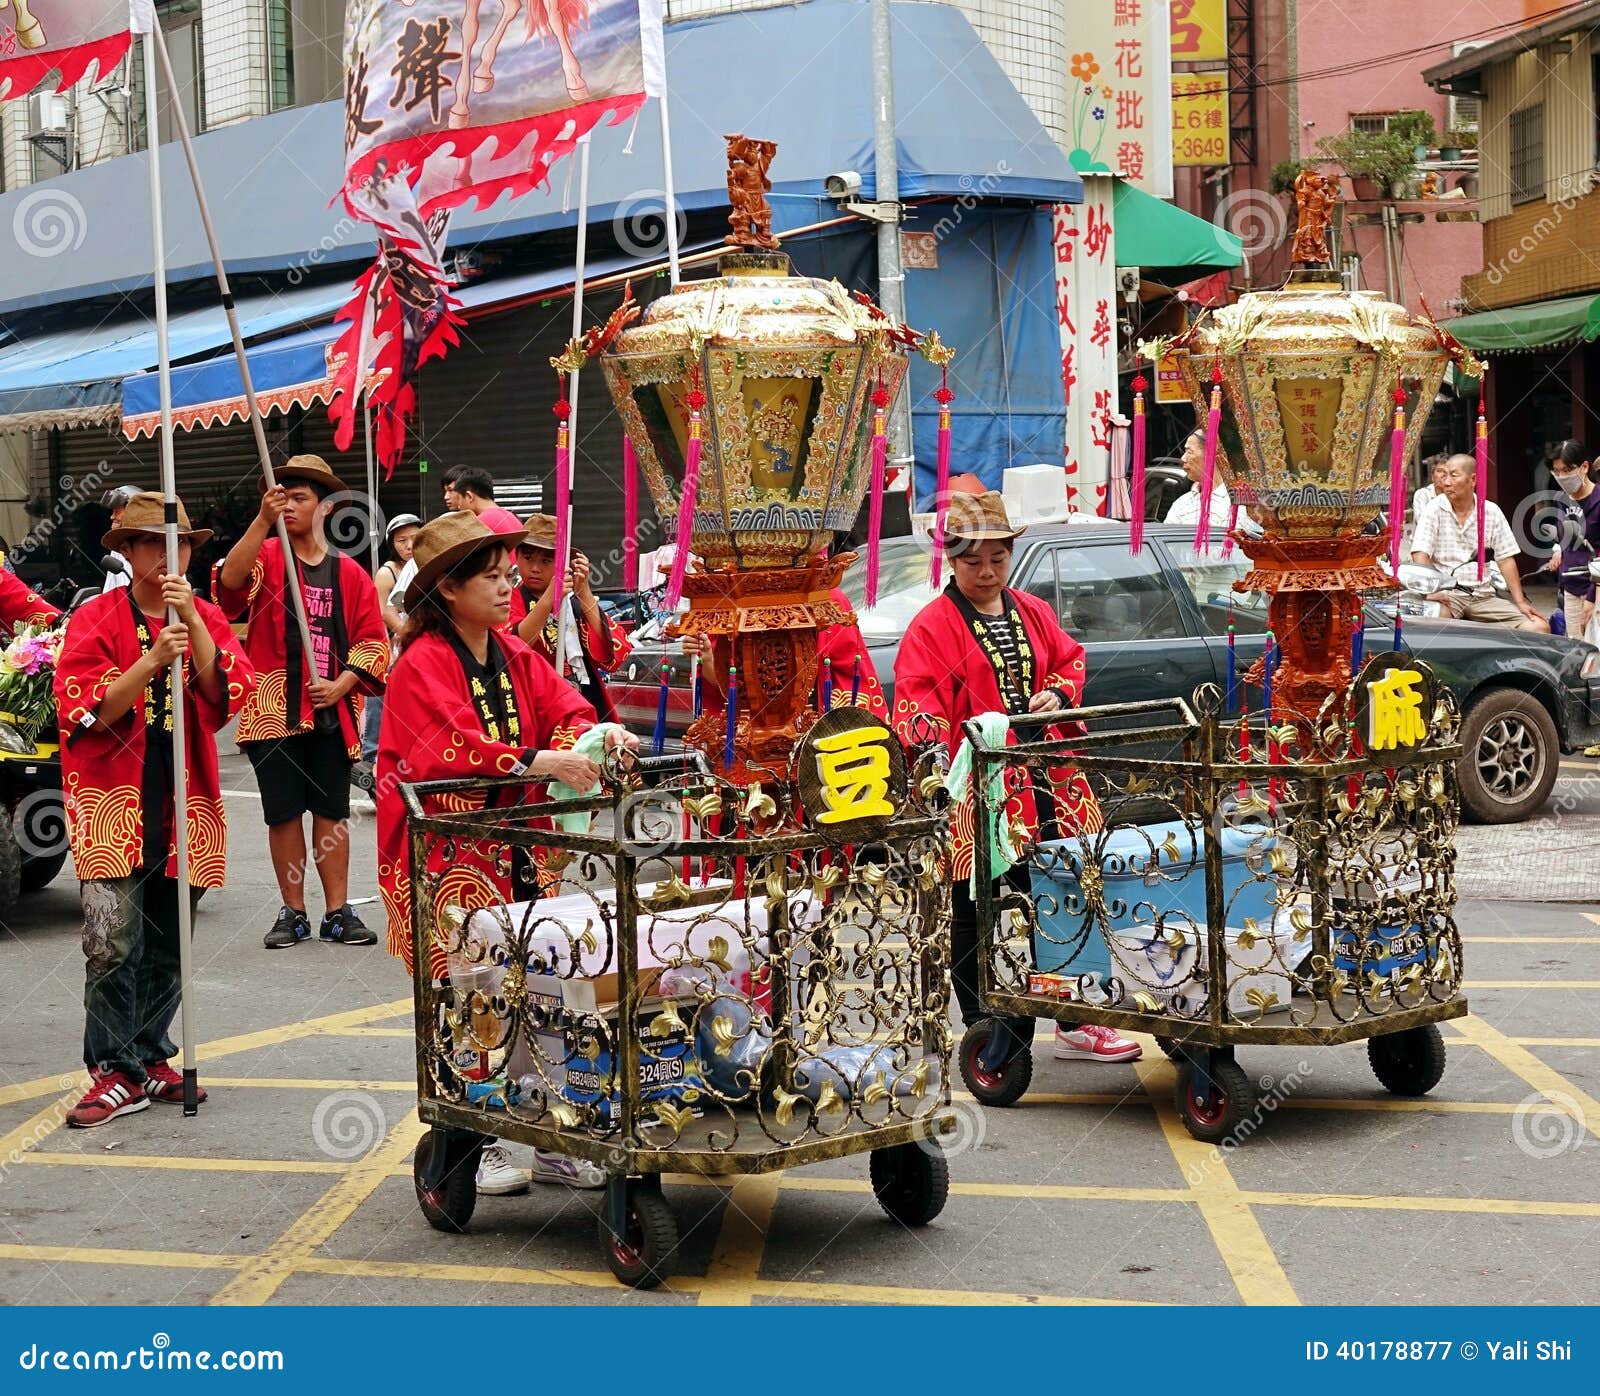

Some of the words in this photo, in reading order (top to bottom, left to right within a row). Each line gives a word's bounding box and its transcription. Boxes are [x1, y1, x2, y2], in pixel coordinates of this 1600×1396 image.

[1114, 0, 1144, 181] 鮮花批發
[1366, 668, 1426, 751] 麻
[812, 726, 895, 824] 豆
